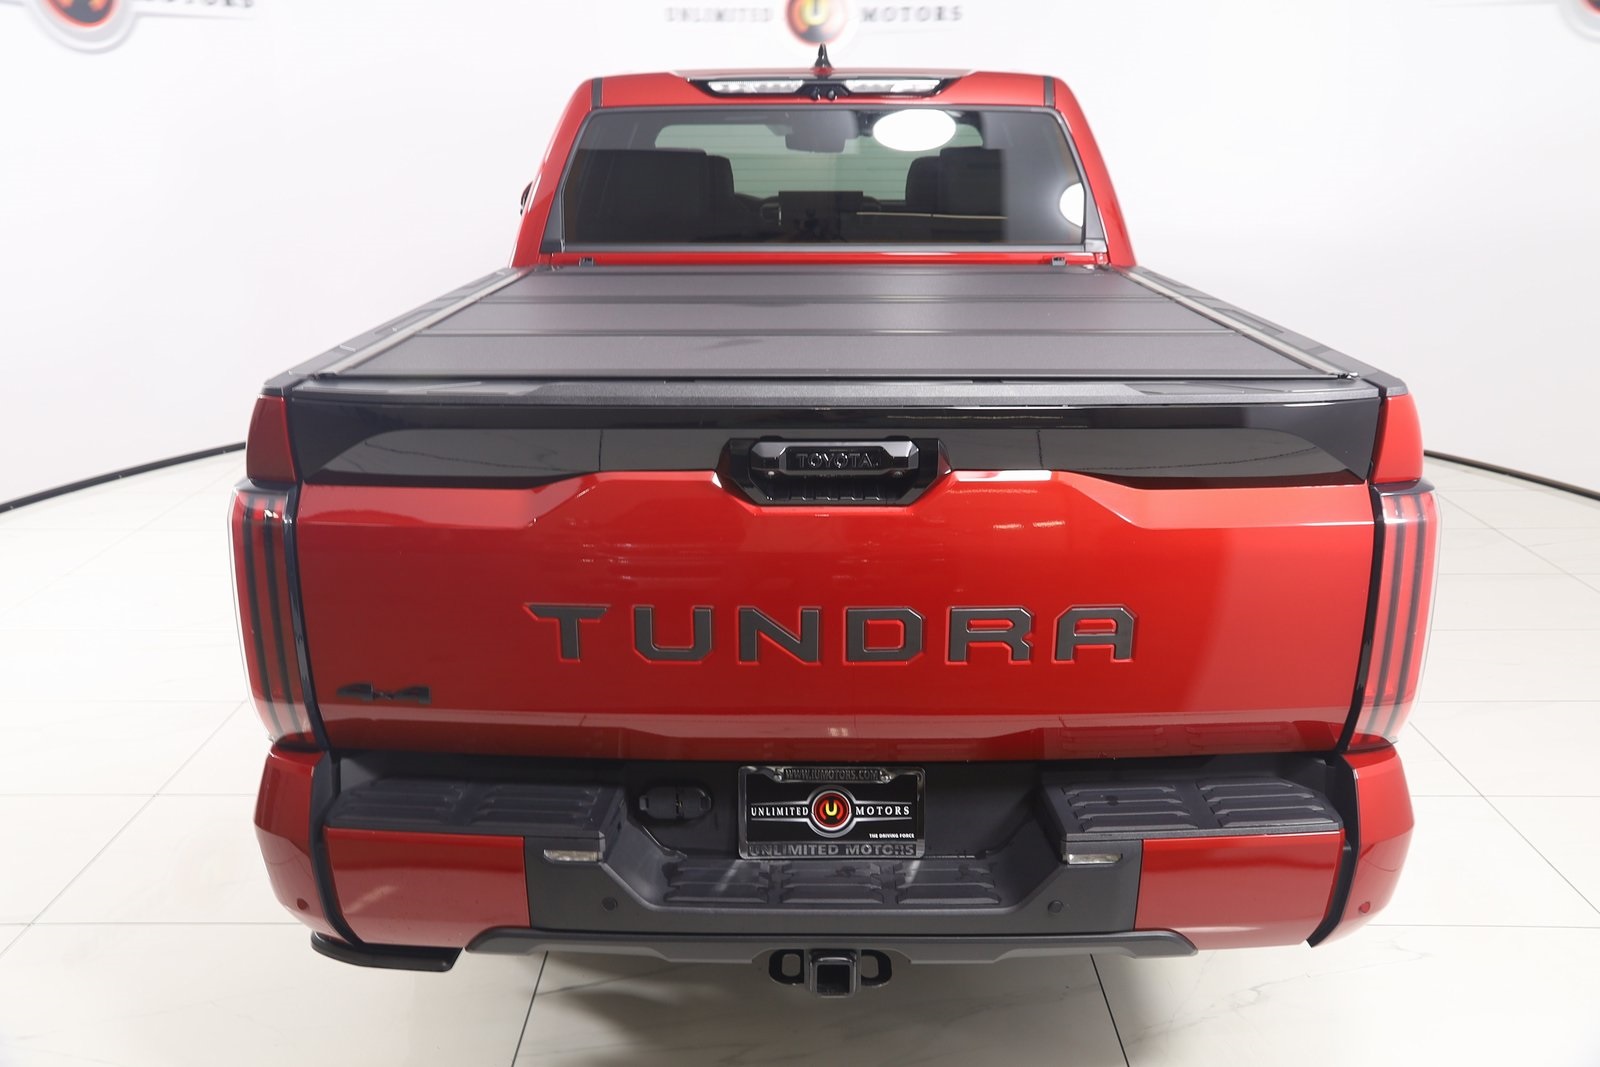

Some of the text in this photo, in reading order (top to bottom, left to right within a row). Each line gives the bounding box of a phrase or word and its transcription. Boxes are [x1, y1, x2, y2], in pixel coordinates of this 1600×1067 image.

[860, 6, 963, 22] MOTORS
[796, 452, 874, 469] TOYOTA
[524, 603, 1138, 664] TUNDRA
[751, 806, 809, 817] UNLIMITED
[855, 805, 911, 816] MOTORS
[749, 844, 915, 856] UNLIMITED MOTORS
